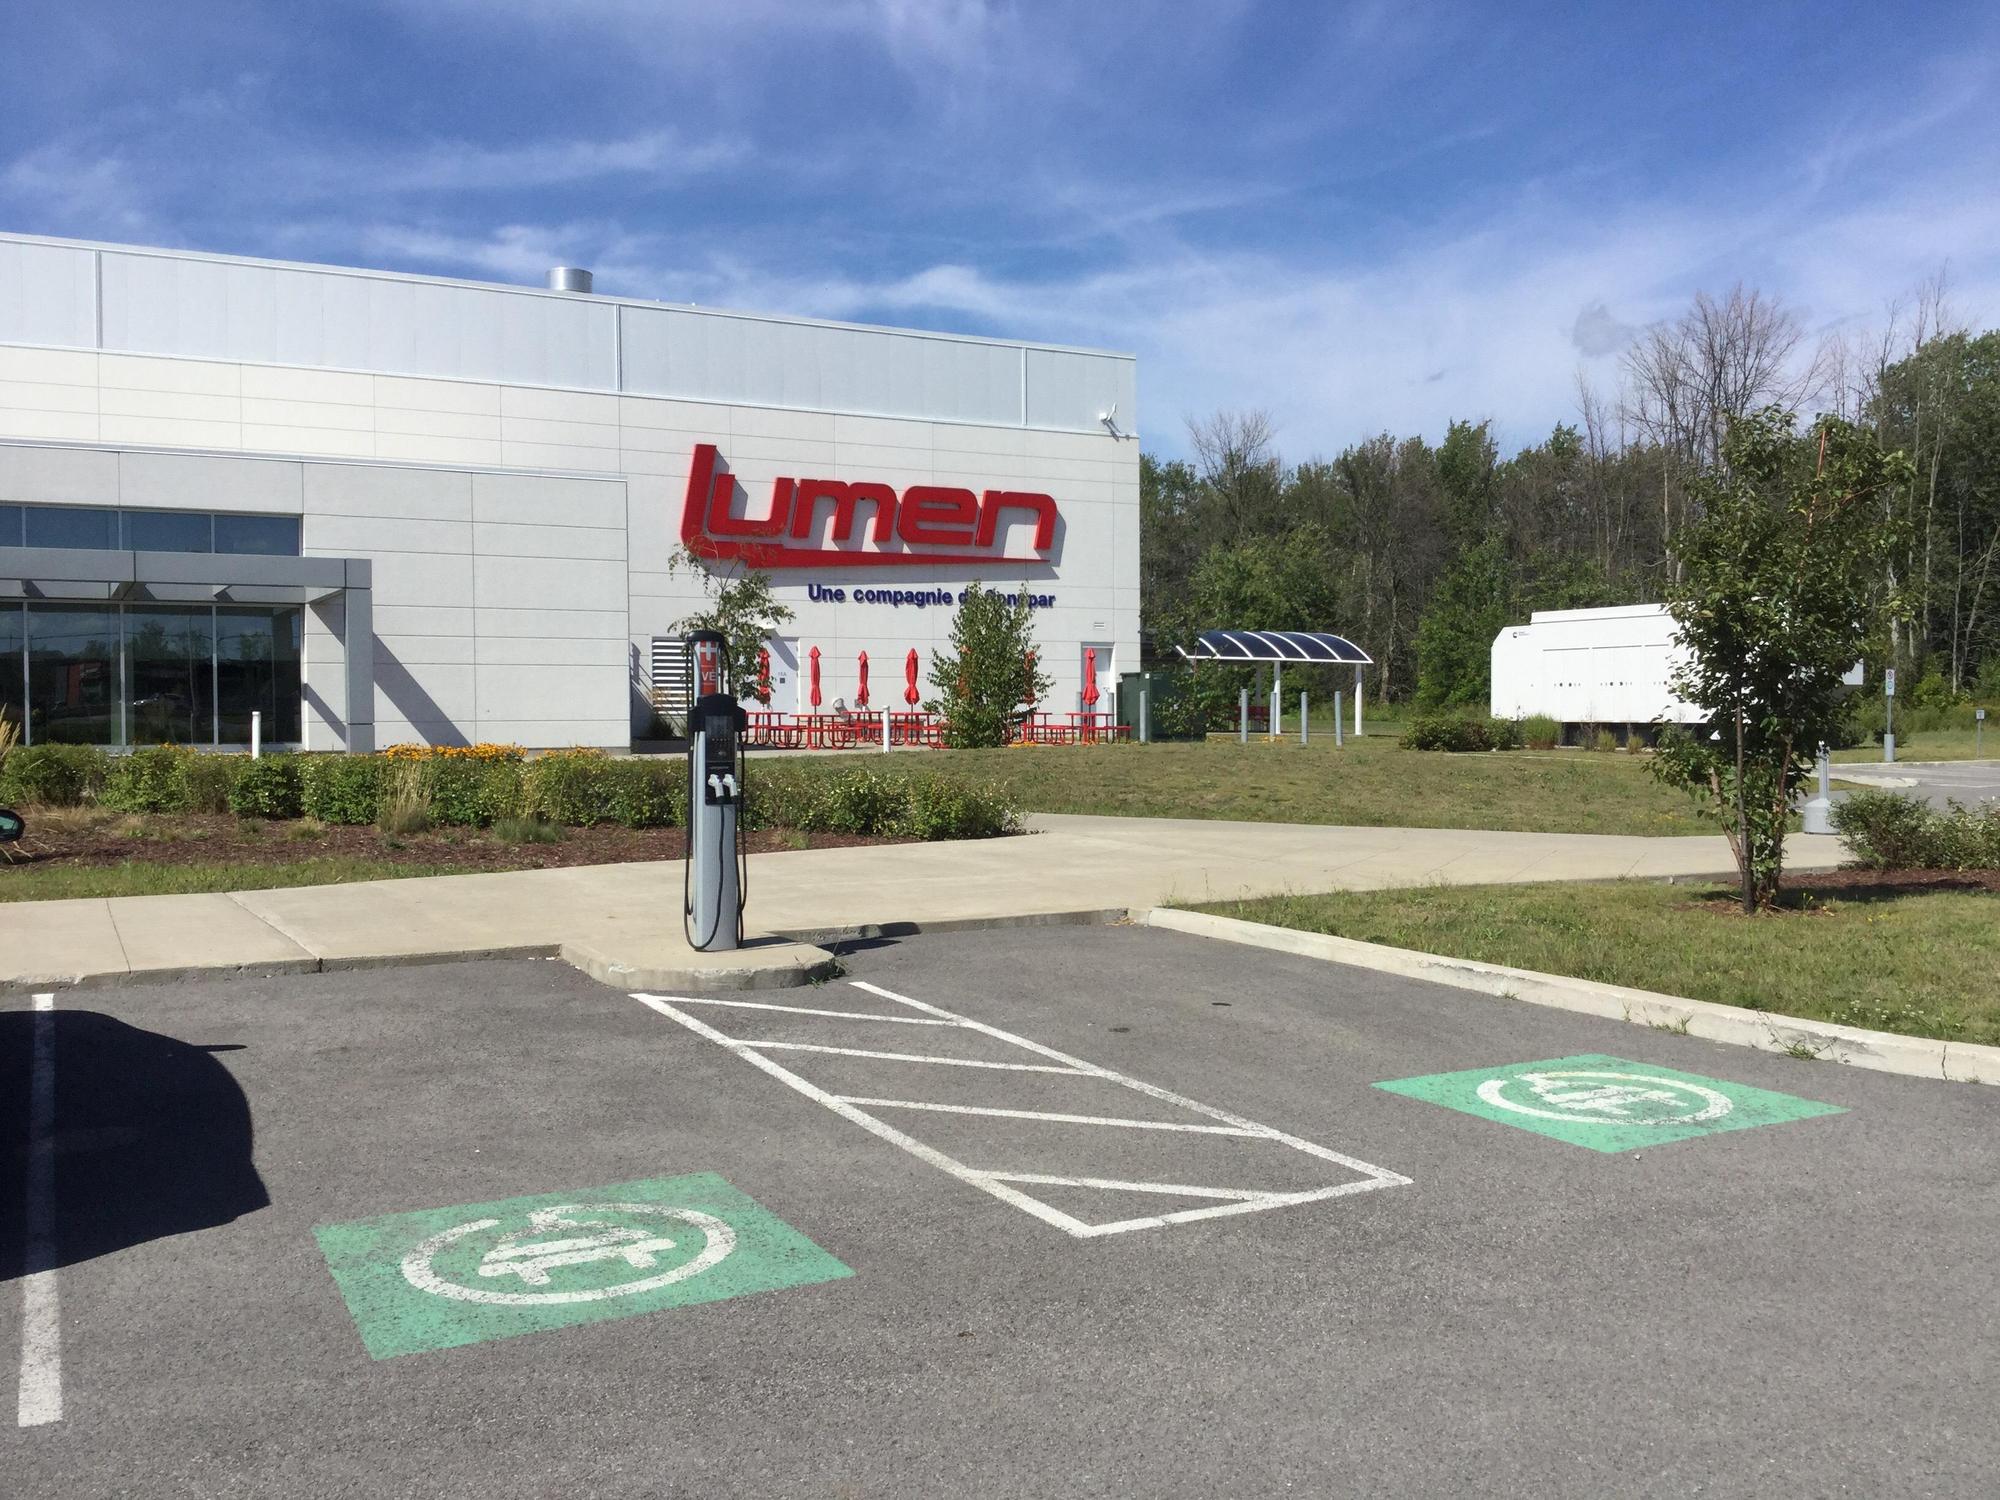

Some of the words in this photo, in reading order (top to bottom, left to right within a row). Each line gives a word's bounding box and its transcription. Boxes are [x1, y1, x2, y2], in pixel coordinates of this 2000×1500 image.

[807, 583, 846, 602] Une
[852, 588, 954, 608] compagnie
[984, 588, 1056, 610] onpar
